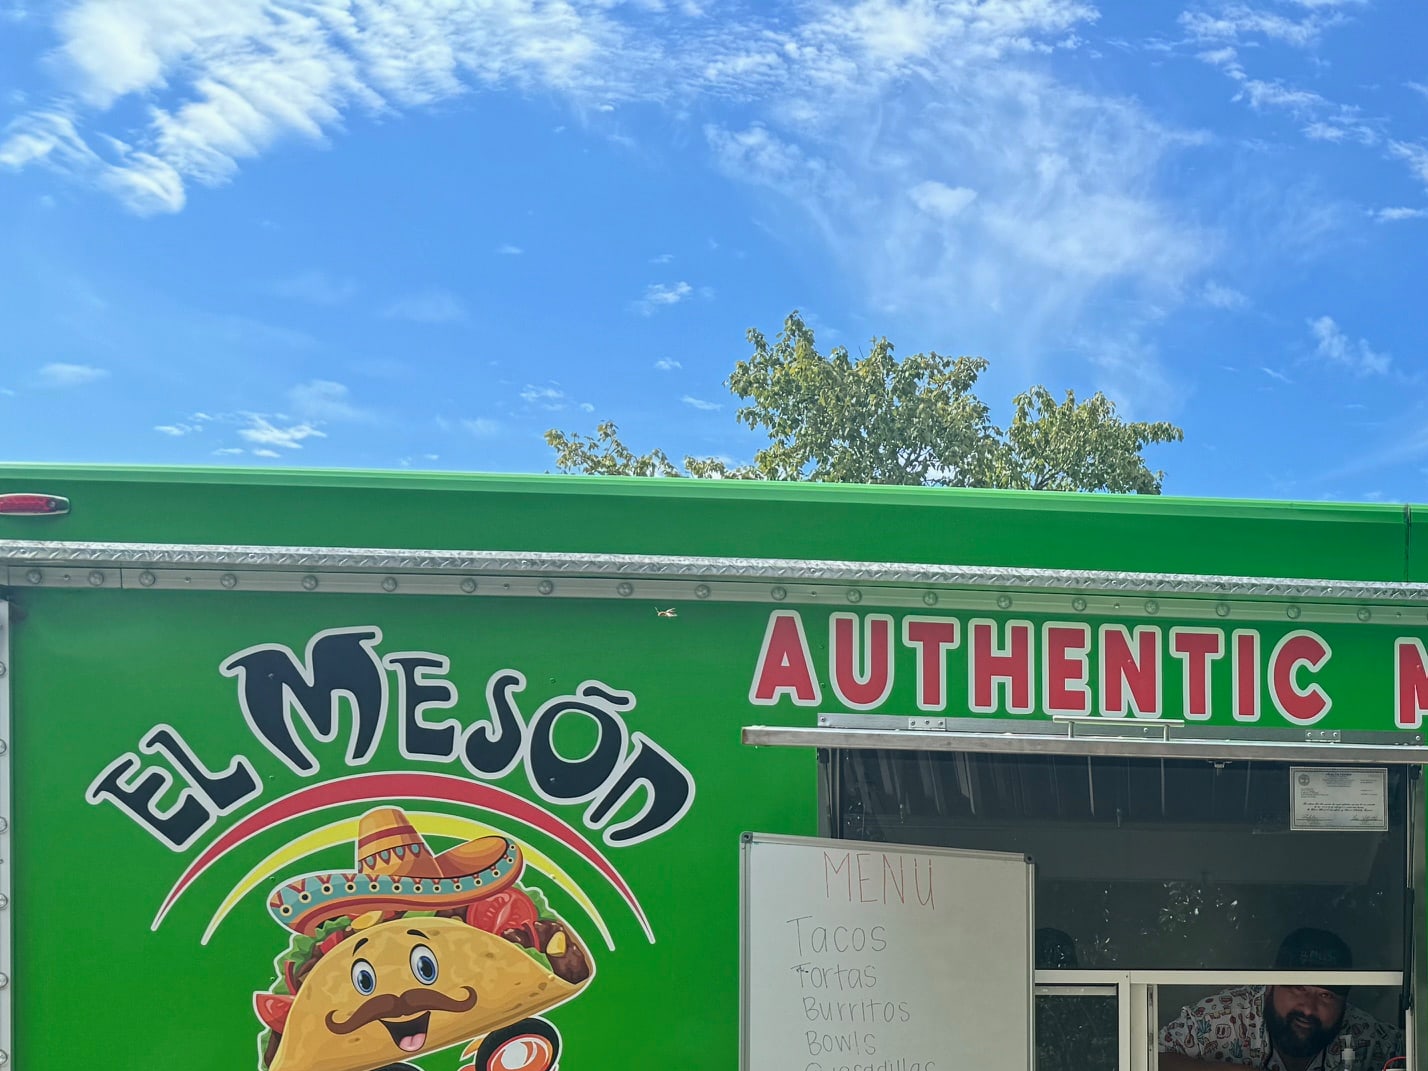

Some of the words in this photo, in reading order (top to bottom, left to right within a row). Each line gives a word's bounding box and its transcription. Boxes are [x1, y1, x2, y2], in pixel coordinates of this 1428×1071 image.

[748, 610, 1332, 725] AUTHENTIC
[824, 851, 935, 910] MENU
[786, 916, 888, 956] Tacos
[803, 996, 911, 1022] Burritos
[805, 1030, 876, 1056] Bowls
